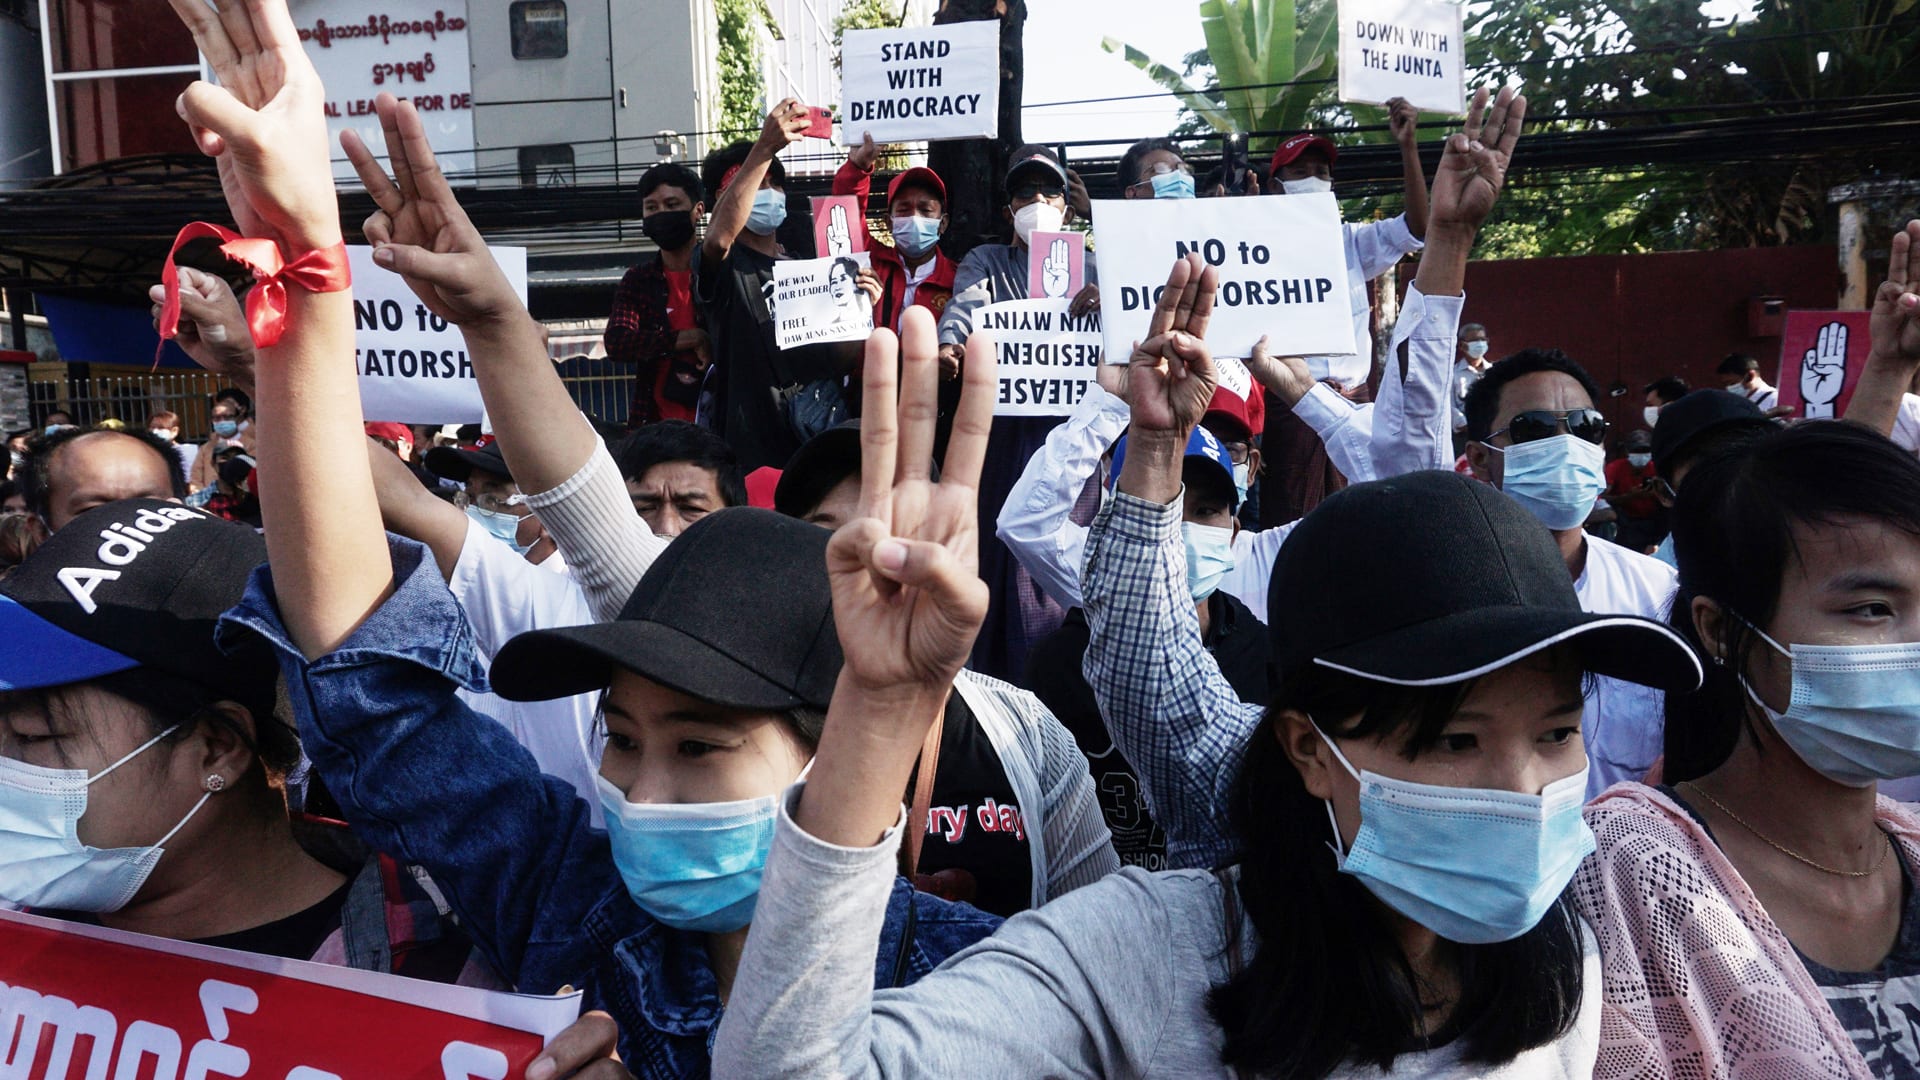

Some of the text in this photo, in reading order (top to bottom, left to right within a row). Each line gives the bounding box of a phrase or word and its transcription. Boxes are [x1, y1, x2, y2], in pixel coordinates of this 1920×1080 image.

[1357, 21, 1448, 53] DOWN WITH
[881, 40, 950, 62] STAND
[1362, 48, 1443, 78] THE JUNTA
[887, 67, 942, 89] WITH
[324, 101, 341, 117] AL
[414, 95, 444, 111] FOR
[851, 94, 981, 121] DEMOCRACY
[1176, 238, 1270, 266] NO to
[778, 274, 814, 288] WE WANT
[778, 284, 829, 301] OUR LEADER
[1121, 277, 1332, 311] DICORSHIP
[353, 300, 448, 332] NO to
[782, 316, 807, 330] FREE
[982, 311, 1101, 332] WIN MYINT
[784, 335, 802, 344] DAW
[356, 349, 476, 379] TATORSH
[995, 342, 1099, 366] RESIDEN
[999, 378, 1095, 404] ELEASE
[925, 797, 1024, 842] ry day
[1123, 853, 1168, 871] SHION
